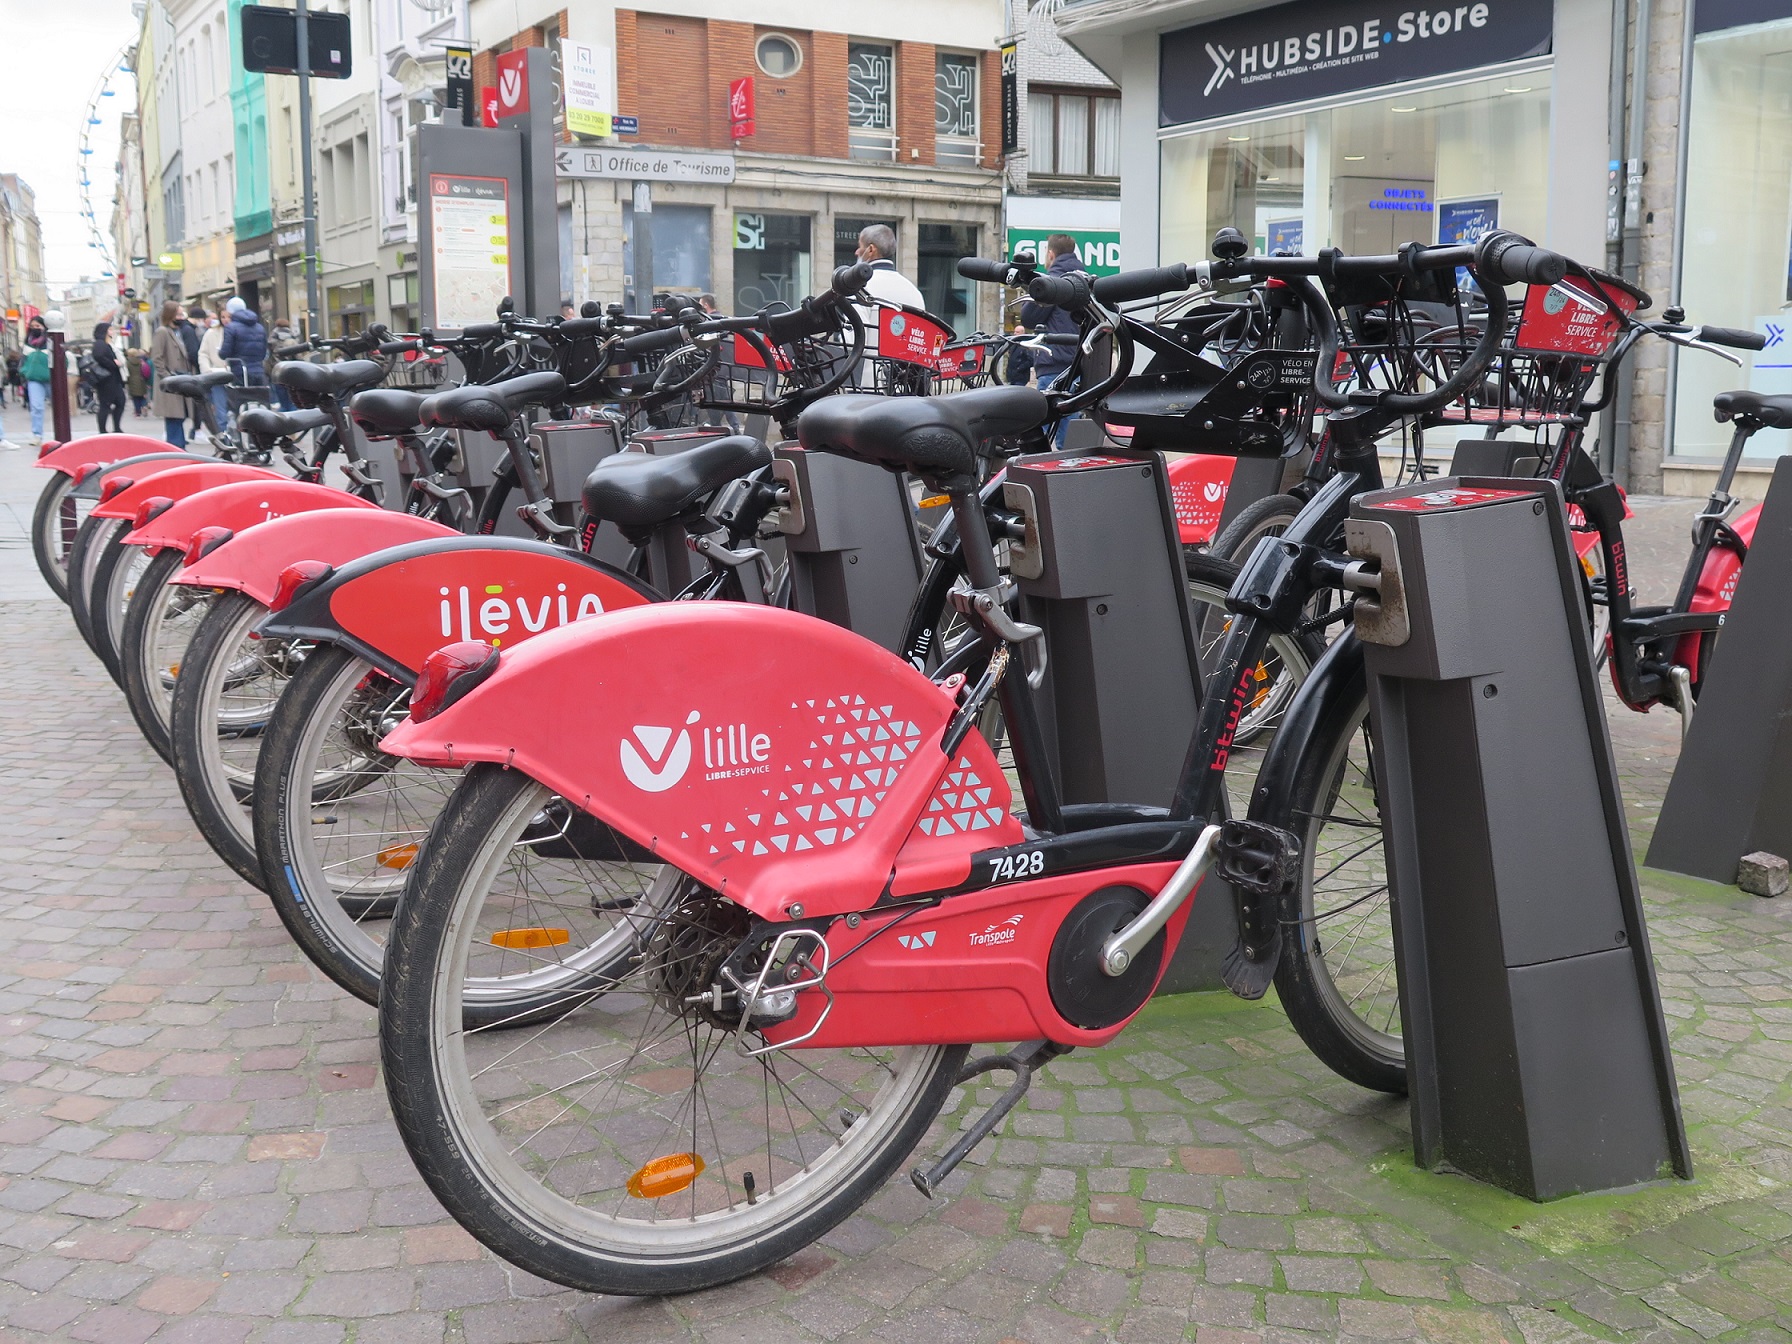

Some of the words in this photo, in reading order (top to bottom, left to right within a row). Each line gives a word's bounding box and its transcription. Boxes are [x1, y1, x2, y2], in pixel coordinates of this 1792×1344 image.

[1342, 57, 1350, 65] DE
[1351, 54, 1364, 63] SITE
[1365, 51, 1379, 60] WEB
[608, 157, 649, 173] Office
[653, 159, 668, 173] de
[673, 160, 730, 176] Tourisme
[1384, 188, 1425, 199] OBJETS
[1369, 200, 1434, 212] CONNECTÉS
[1571, 311, 1598, 324] LIBRE-
[911, 327, 924, 337] VÉLO
[1565, 324, 1598, 338] SERVICE
[909, 336, 926, 345] LIBRE-
[907, 343, 927, 355] SERVICE
[1282, 359, 1302, 367] VÉLO
[279, 775, 287, 804] PLUS
[277, 809, 289, 864] MARATHON
[989, 850, 1044, 882] 7428
[301, 903, 338, 954] SCHWALBE
[969, 928, 1015, 946] Transpole
